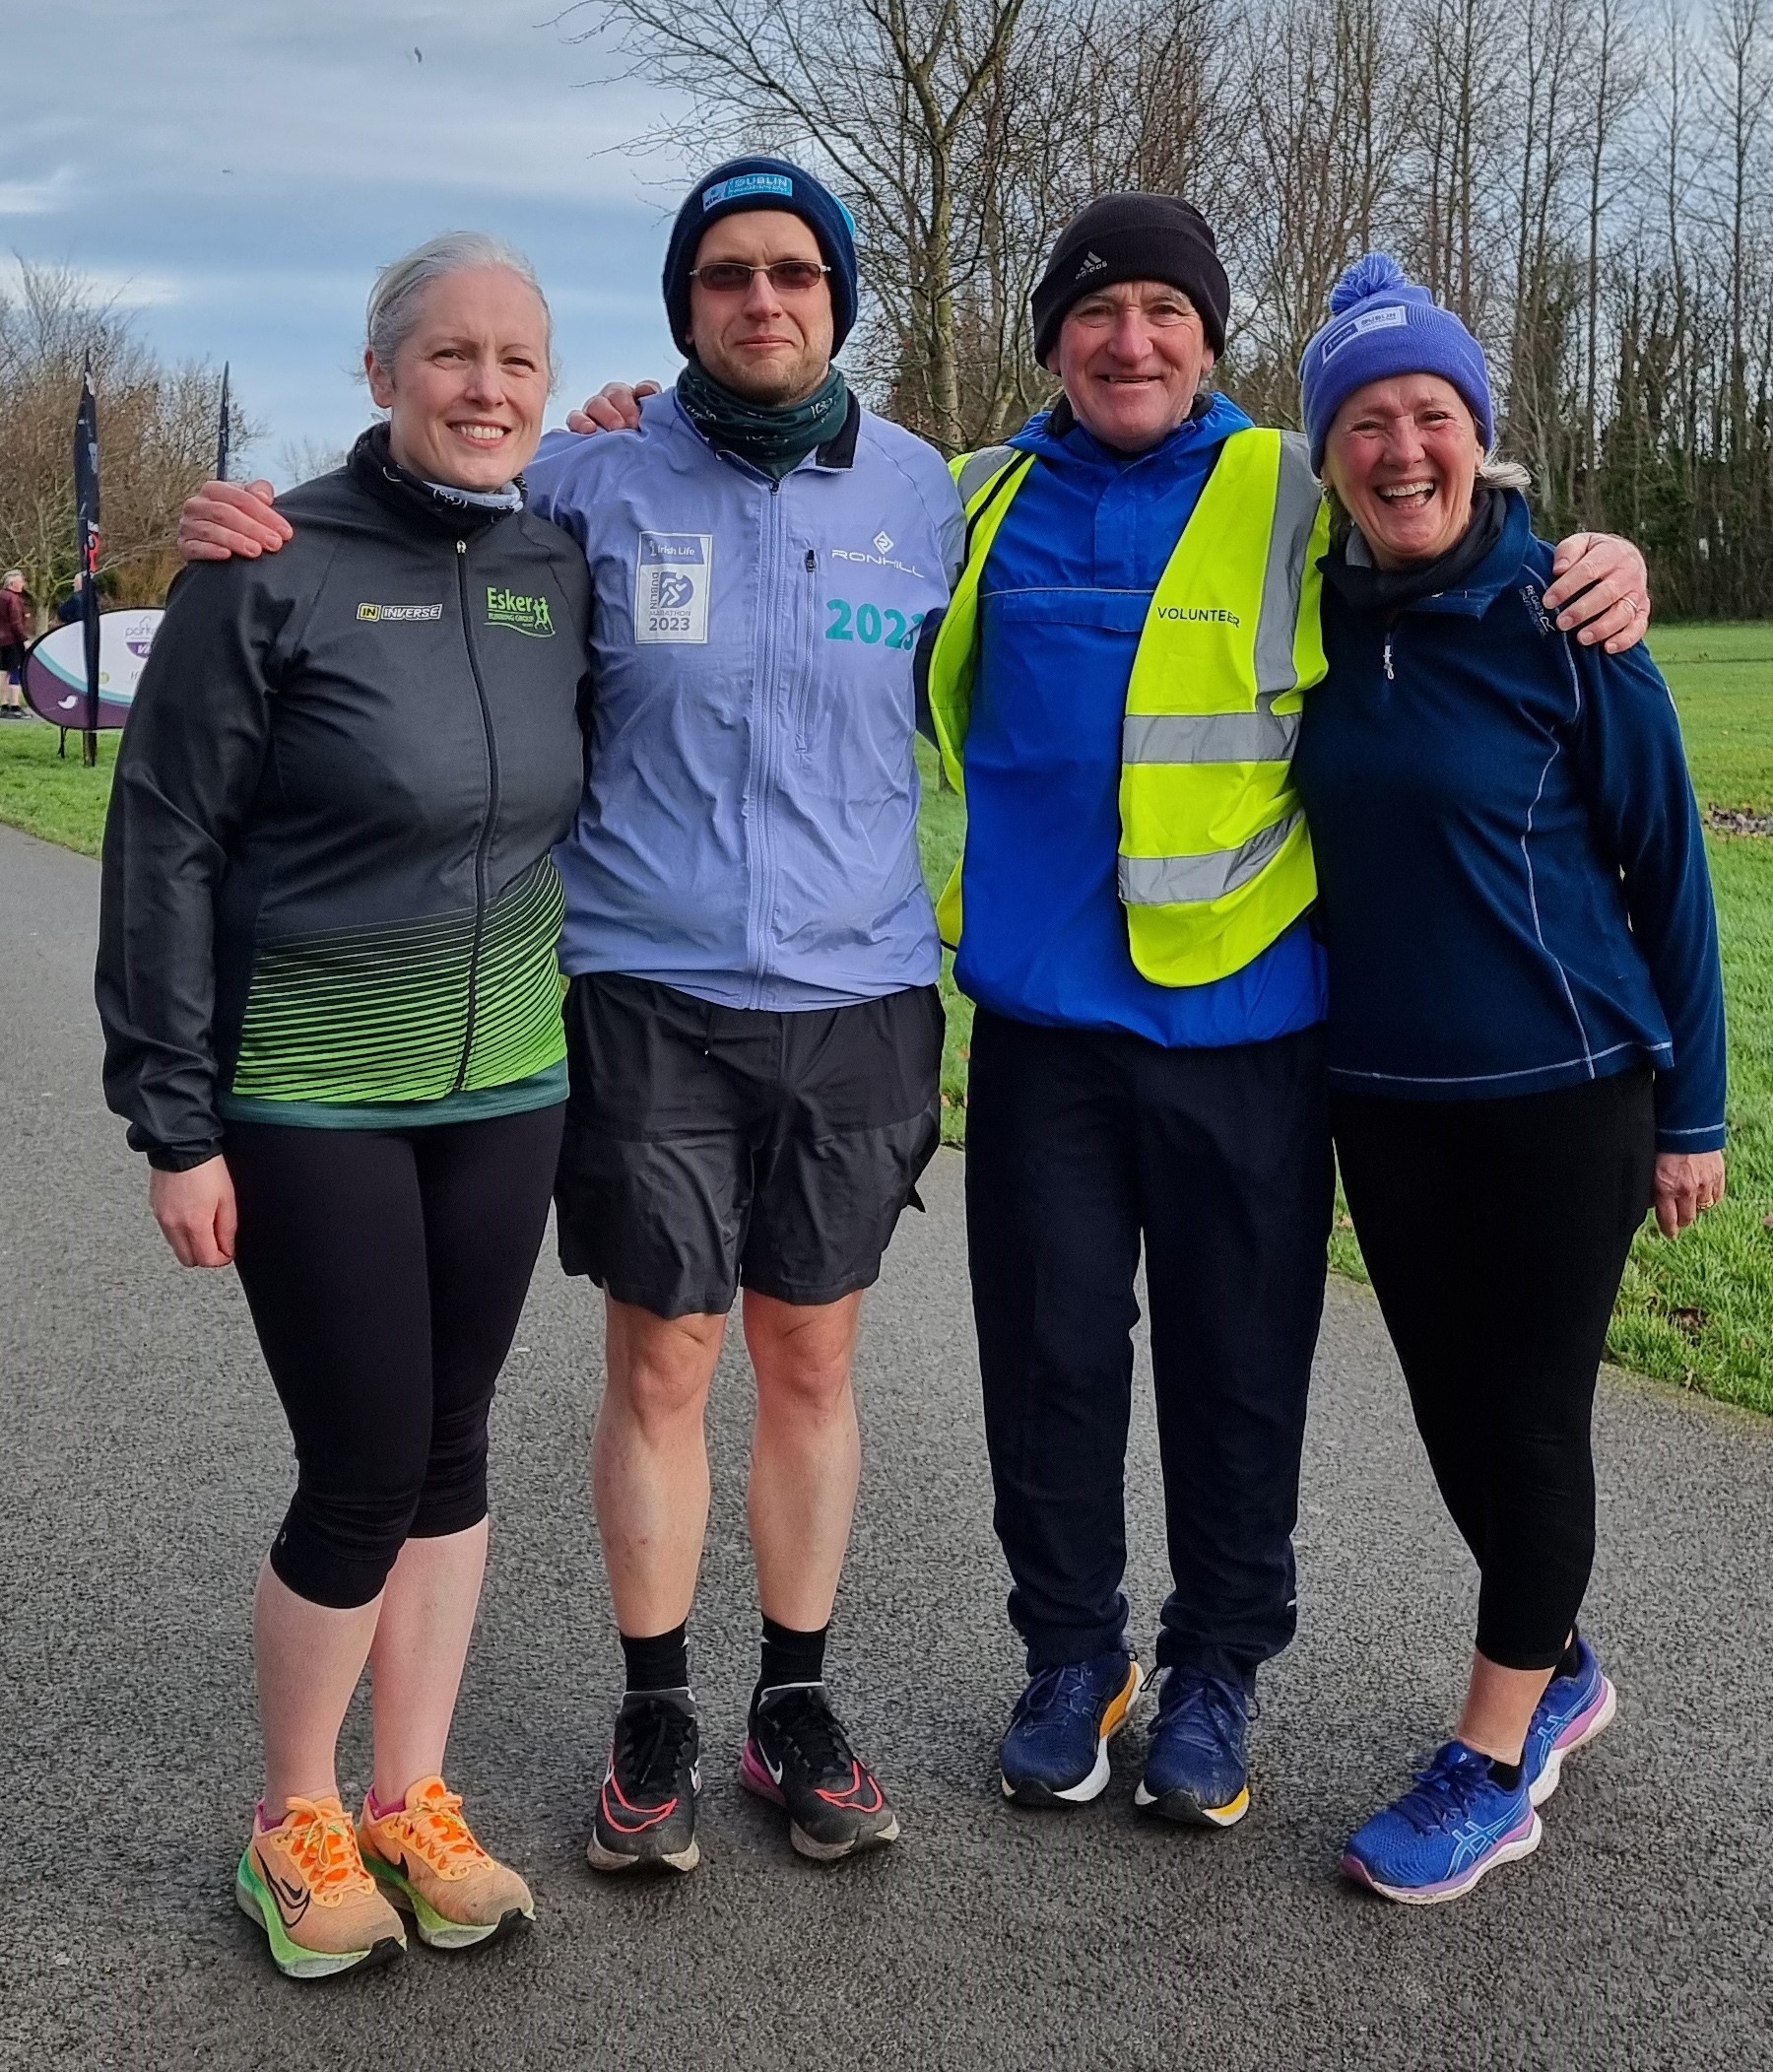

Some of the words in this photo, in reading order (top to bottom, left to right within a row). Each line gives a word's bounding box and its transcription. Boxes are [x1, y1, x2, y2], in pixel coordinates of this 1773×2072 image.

[735, 176, 788, 187] DUBLIN
[1361, 312, 1397, 325] DUBLIN
[657, 545, 677, 556] Irish
[678, 546, 695, 556] Life
[831, 549, 925, 578] RONHILL
[650, 571, 659, 610] DUBLIN
[488, 587, 533, 612] Esker
[361, 606, 375, 617] IN
[383, 605, 440, 619] INVERSE
[1157, 606, 1240, 629] VOLUNTEER
[649, 617, 690, 632] 2023
